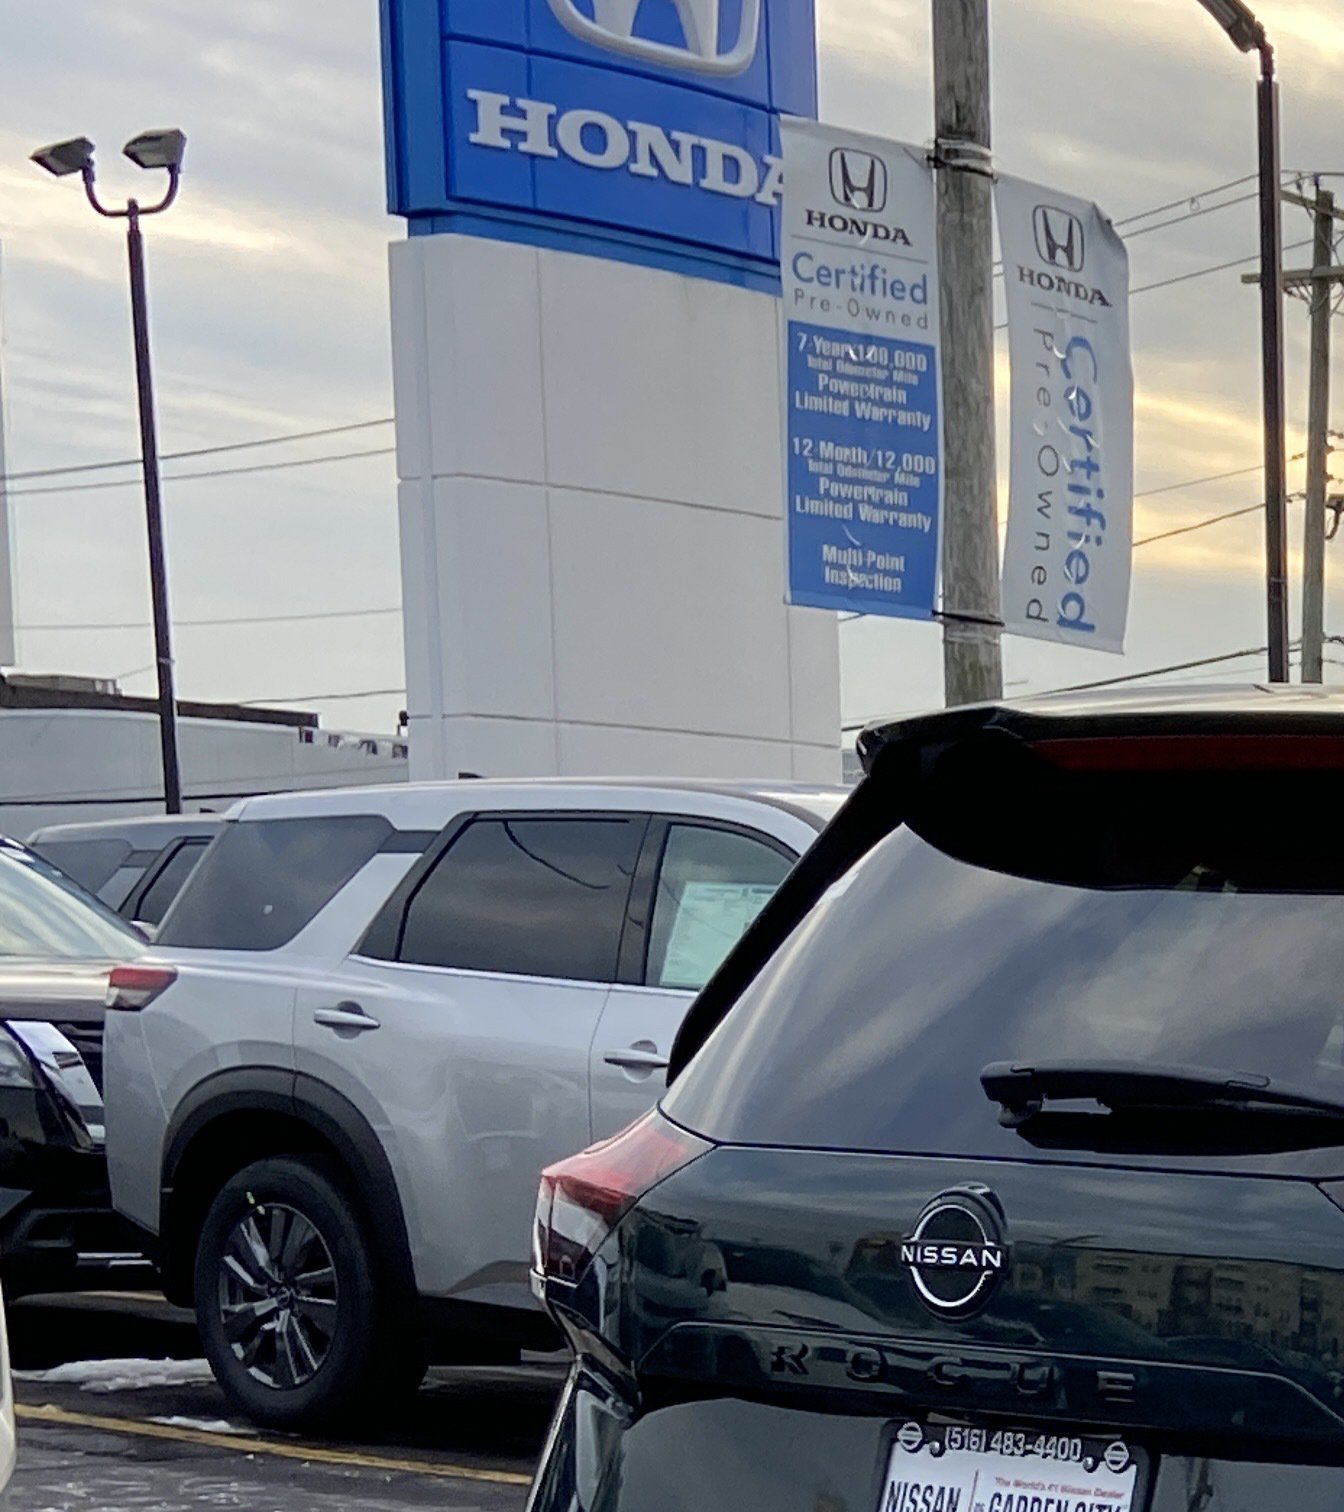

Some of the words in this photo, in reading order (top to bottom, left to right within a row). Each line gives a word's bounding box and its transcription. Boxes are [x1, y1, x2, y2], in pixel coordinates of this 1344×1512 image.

[805, 208, 914, 248] HONDA
[792, 252, 928, 306] Certified
[1017, 265, 1112, 308] HONDA
[794, 288, 929, 330] Pre-Owned
[818, 373, 907, 405] Powertrain
[795, 390, 850, 417] Limited
[854, 401, 932, 432] Warranty
[819, 477, 908, 507] Powertrain
[1056, 336, 1106, 633] Certified
[795, 495, 853, 520] Limited
[859, 502, 932, 533] Warranty
[901, 1245, 1002, 1268] NISSAN
[944, 1426, 987, 1453] (516)
[990, 1431, 1082, 1462] 483-4400
